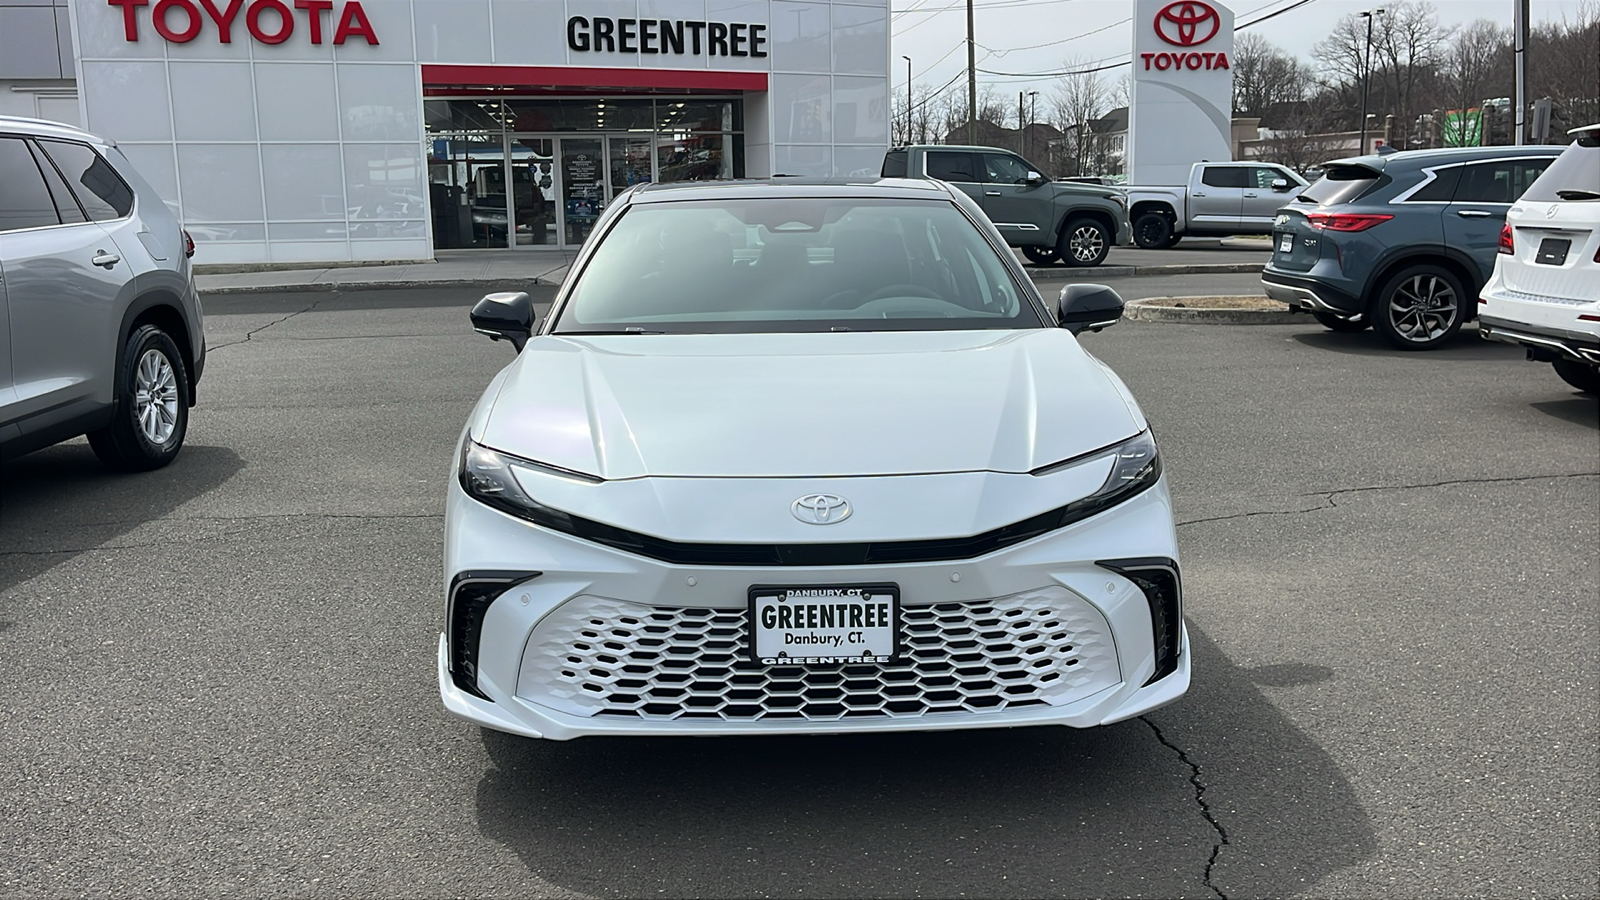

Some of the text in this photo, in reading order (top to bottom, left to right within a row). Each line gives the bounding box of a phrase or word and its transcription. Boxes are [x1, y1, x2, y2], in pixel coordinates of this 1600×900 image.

[108, 0, 380, 45] TOYOTA
[567, 16, 767, 57] GREENTREE
[1141, 52, 1230, 71] TOYOTA
[761, 603, 889, 629] GREENTREE
[785, 632, 865, 647] Danbury, CT.
[761, 656, 890, 664] GREENTREE
